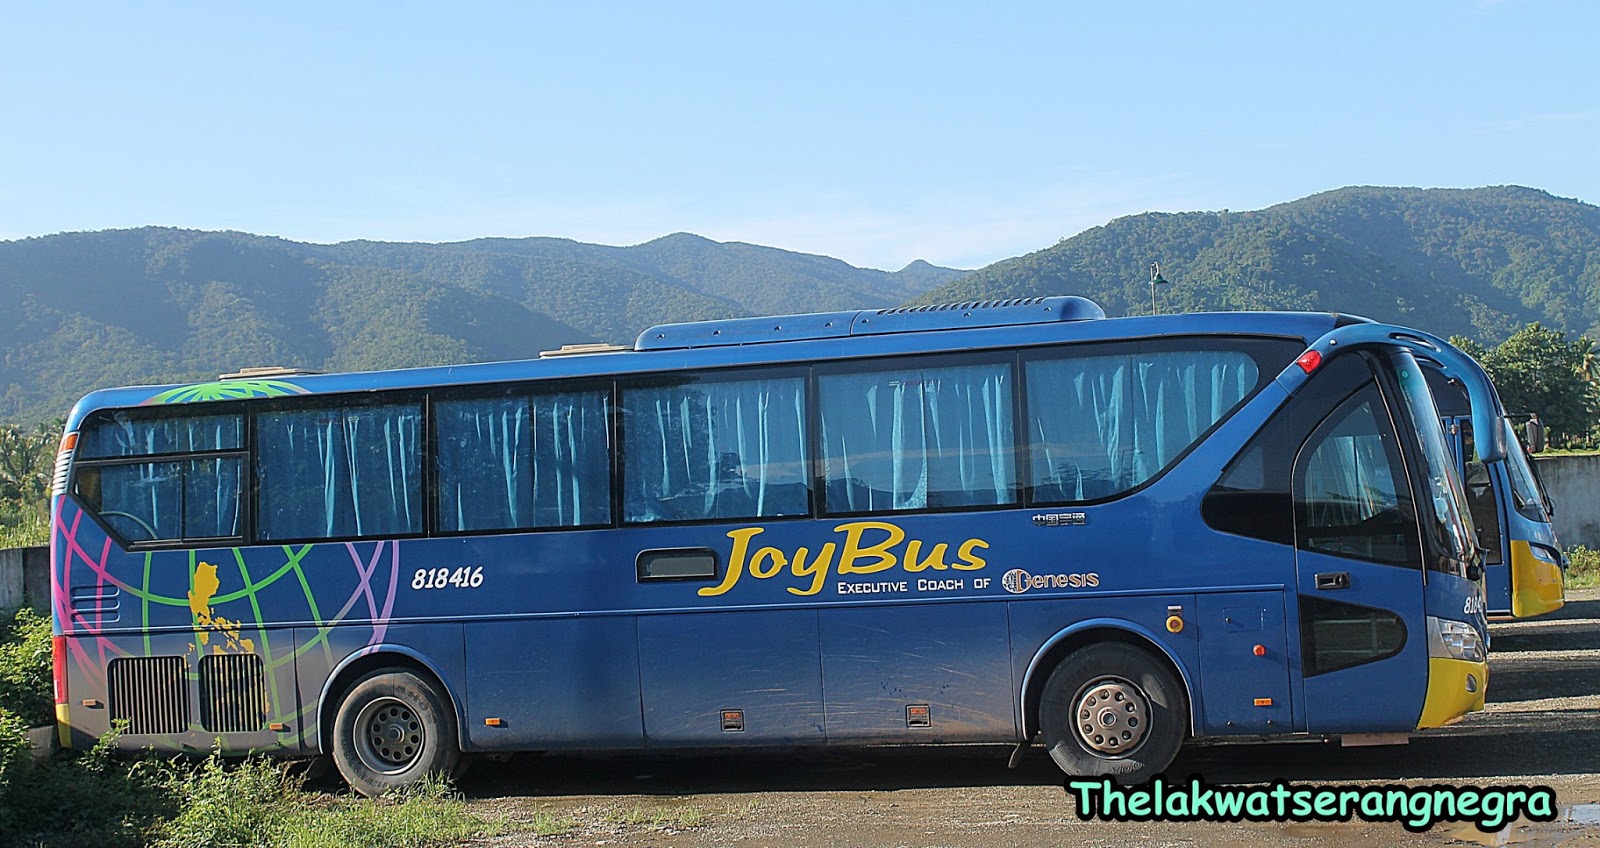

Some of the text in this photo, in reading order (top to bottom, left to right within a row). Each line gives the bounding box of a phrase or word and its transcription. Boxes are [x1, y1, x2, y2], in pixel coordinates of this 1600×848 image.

[697, 521, 990, 596] JoyBus
[411, 566, 484, 590] 818416
[837, 580, 908, 595] EXECUTIVE
[917, 577, 964, 592] COACH
